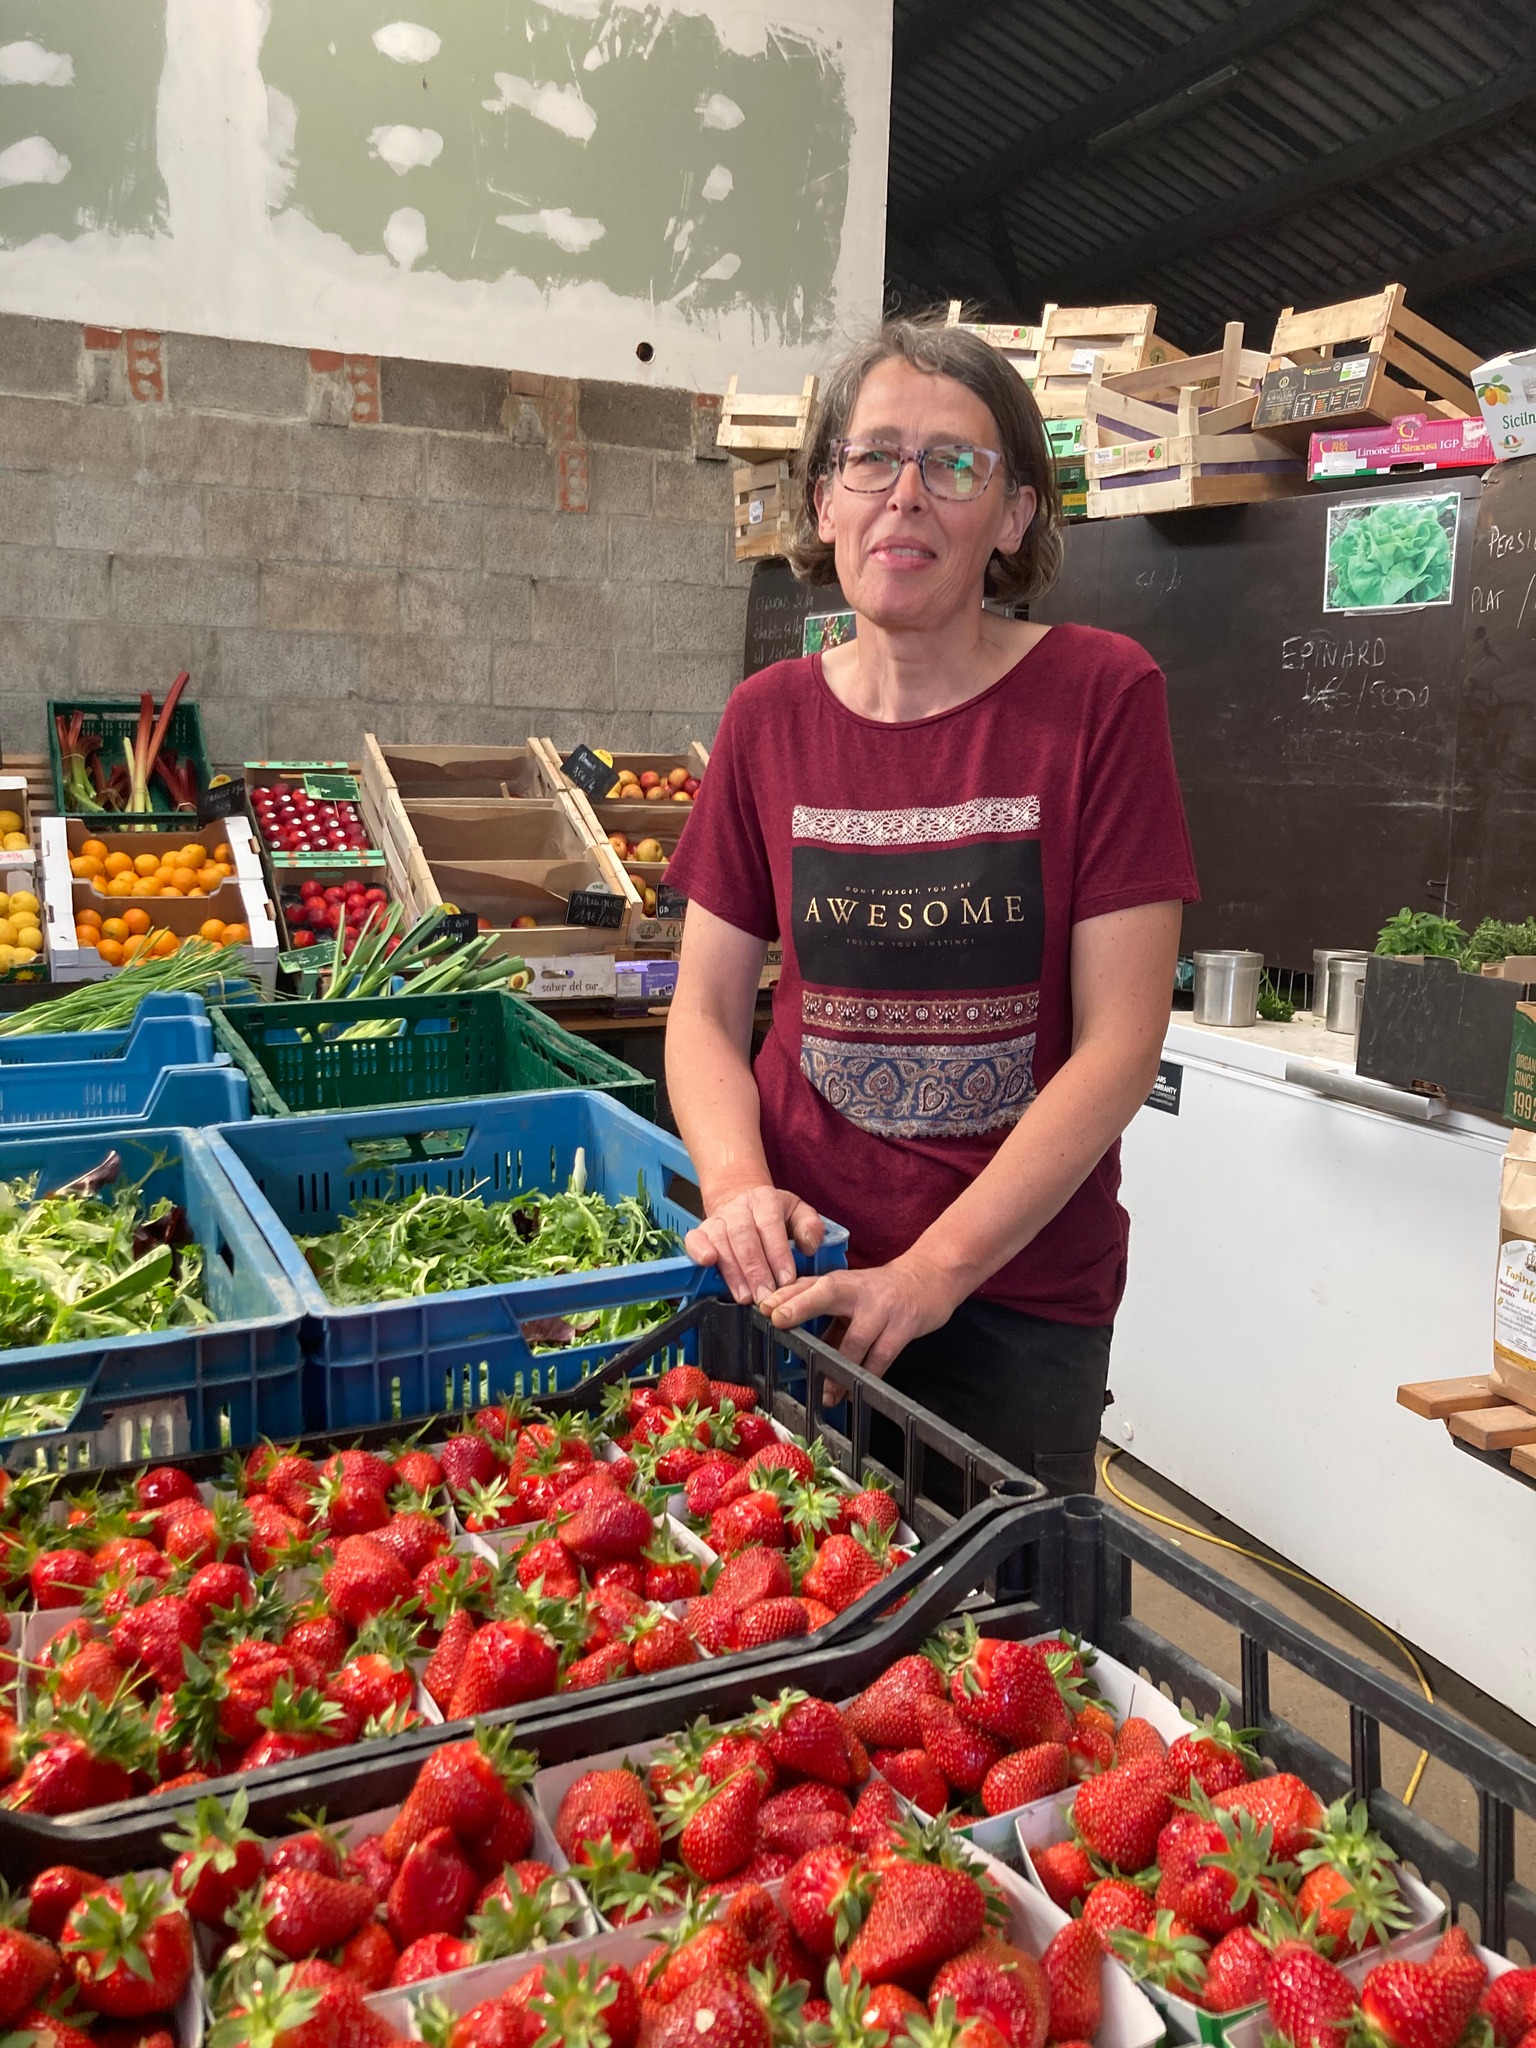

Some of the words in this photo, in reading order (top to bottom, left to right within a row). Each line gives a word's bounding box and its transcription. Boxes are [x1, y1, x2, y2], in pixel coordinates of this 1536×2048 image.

[1357, 447, 1390, 458] Limone
[1390, 443, 1400, 454] di
[1401, 442, 1438, 453] Siracusa
[1440, 438, 1459, 449] IGP
[1488, 525, 1536, 559] PERSI
[1471, 586, 1505, 613] PLAT
[845, 885, 875, 895] DON'T
[927, 885, 946, 893] YOU
[952, 881, 971, 890] ARE
[804, 895, 1025, 930] AWESOME
[846, 938, 885, 947] FOLLOW
[924, 938, 974, 947] INSTINCT
[569, 980, 582, 991] del
[1153, 1083, 1177, 1095] ARRANTY
[1514, 1070, 1535, 1091] SINCE
[1505, 1265, 1536, 1288] Farine
